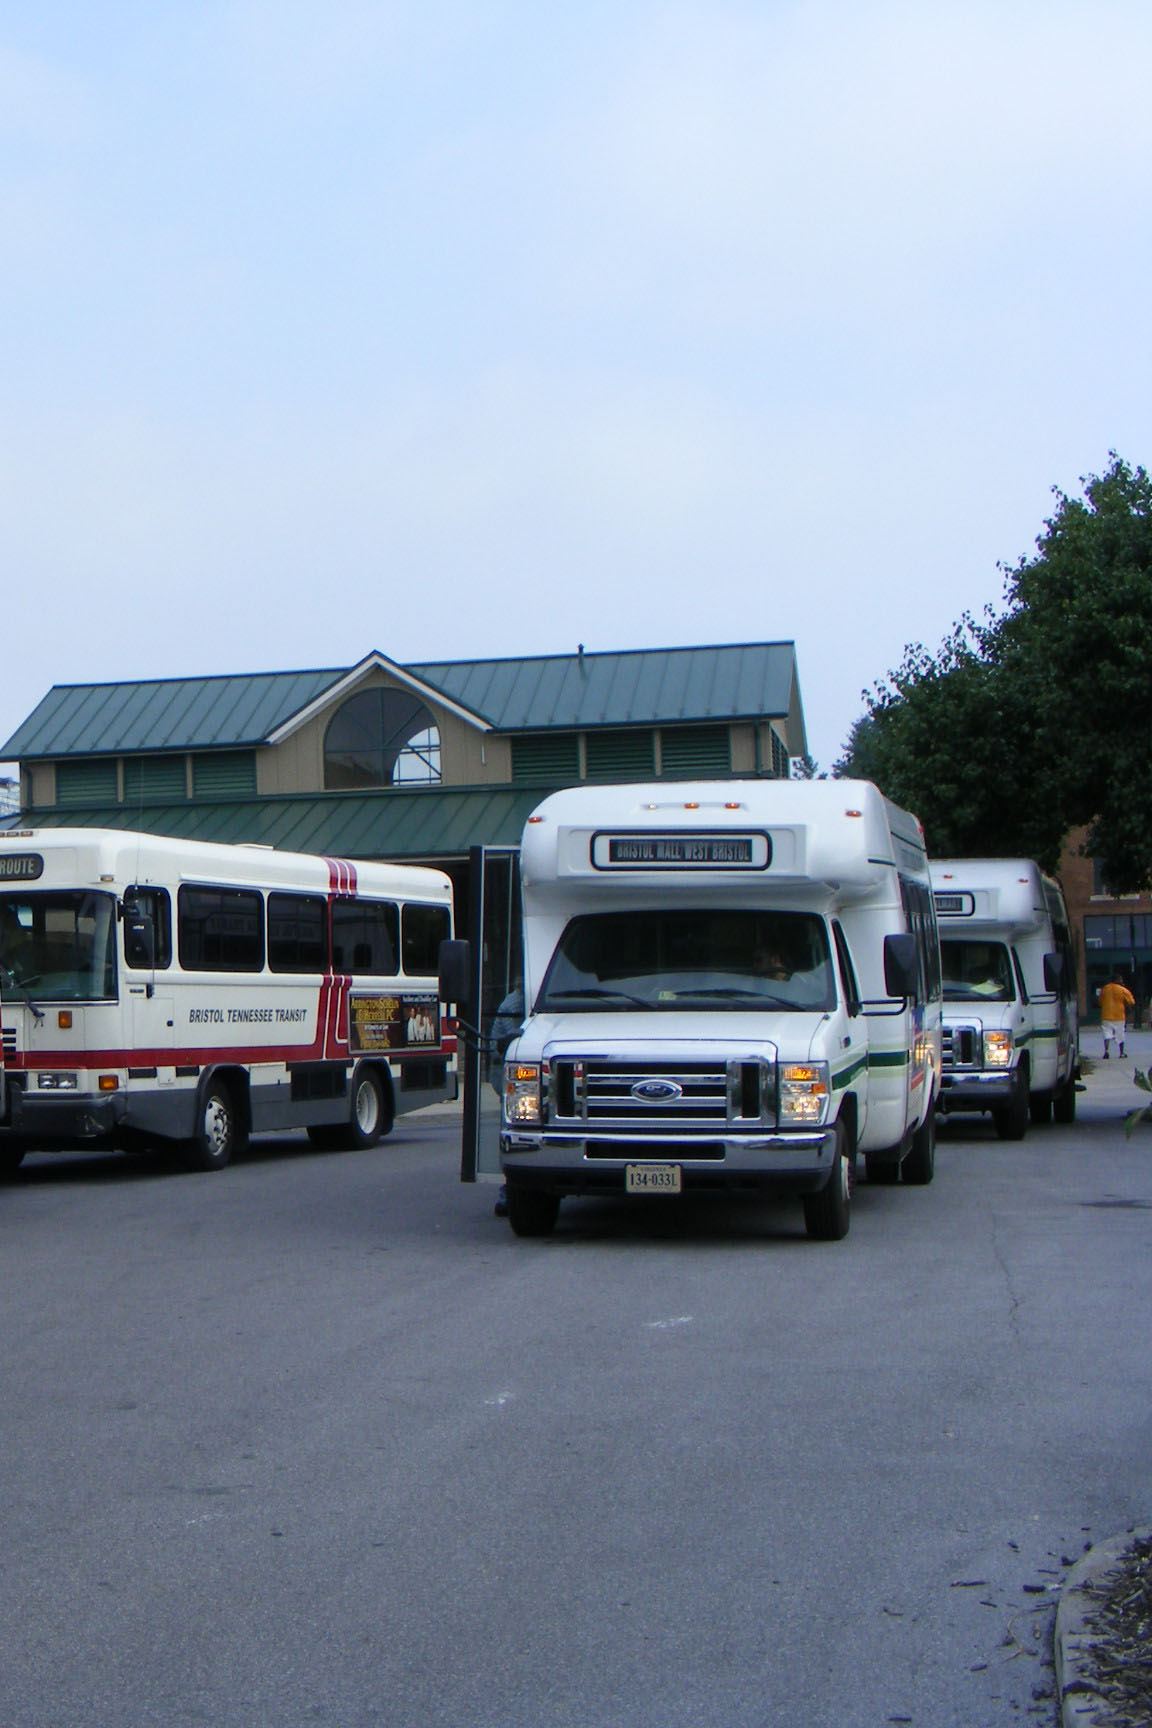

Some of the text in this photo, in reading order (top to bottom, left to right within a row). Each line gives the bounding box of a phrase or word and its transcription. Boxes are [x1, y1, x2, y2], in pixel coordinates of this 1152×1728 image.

[617, 841, 749, 860] BRISTOL MALL WEST BRISTOL
[189, 1008, 307, 1023] BRISTOL TENNESSEE TRANSIT
[630, 1172, 678, 1187] 134-033L
